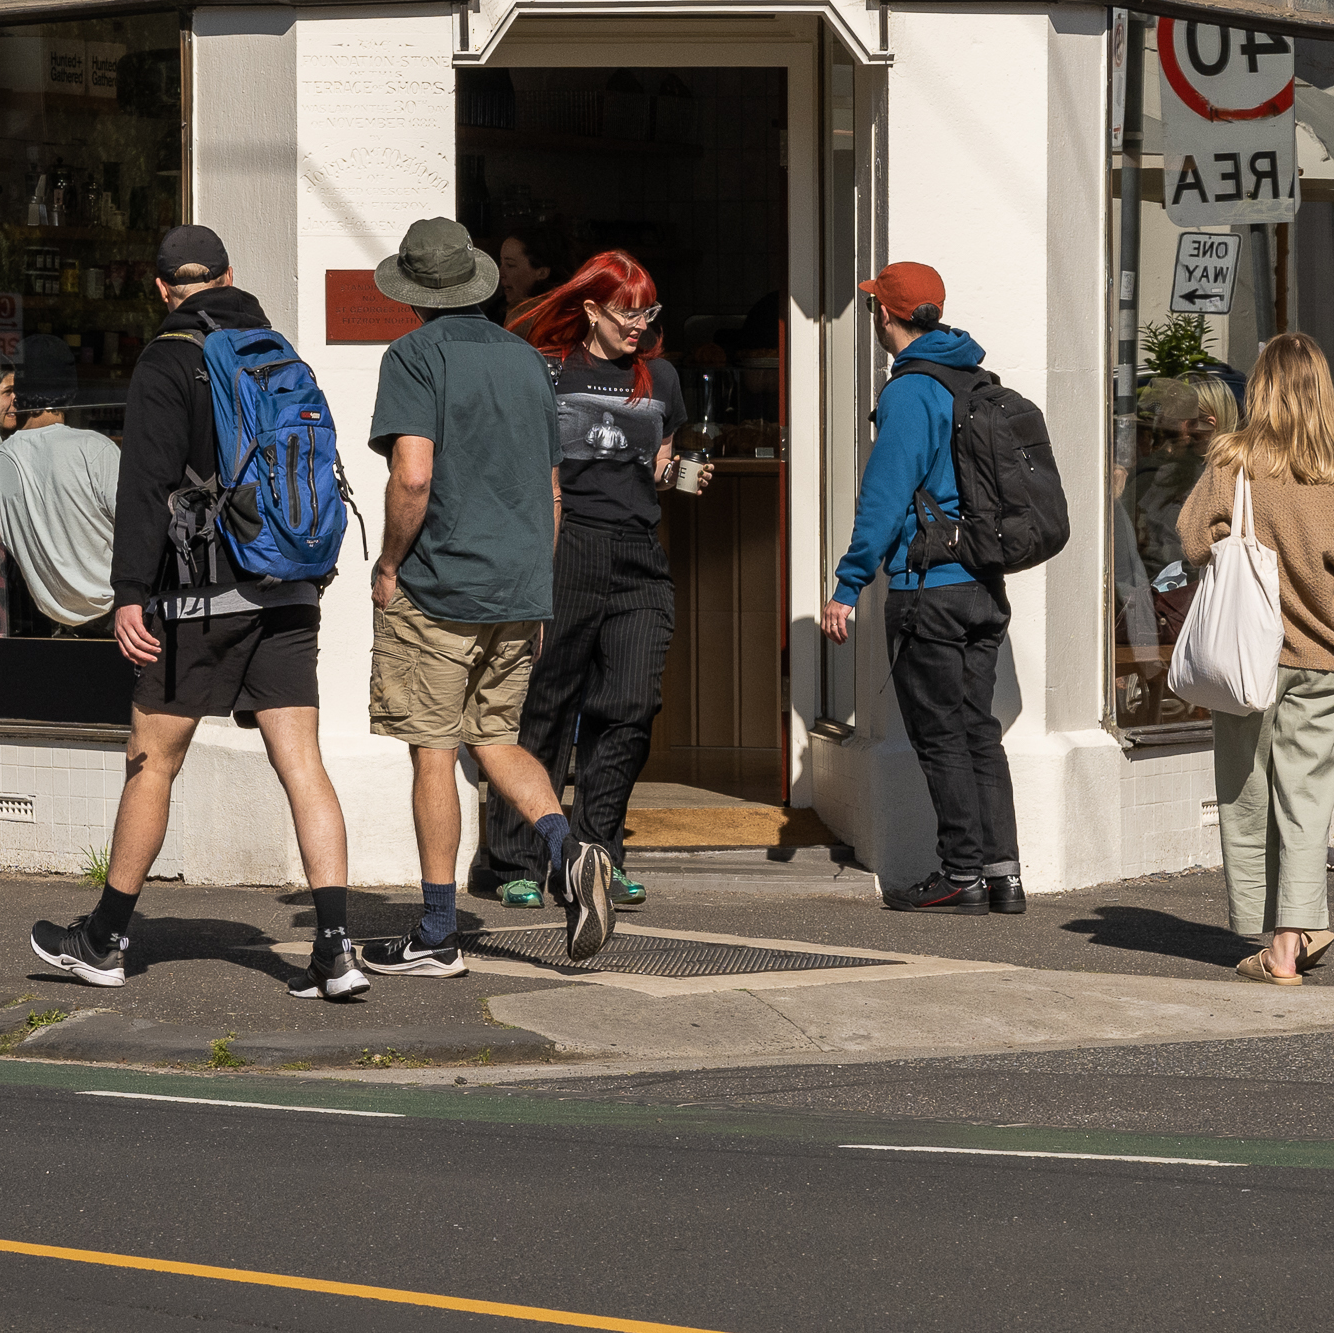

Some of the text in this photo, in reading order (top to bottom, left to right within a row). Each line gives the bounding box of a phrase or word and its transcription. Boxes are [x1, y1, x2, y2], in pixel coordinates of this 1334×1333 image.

[50, 66, 84, 84] Gathered
[301, 80, 373, 94] TERRACE
[301, 104, 327, 114] WAS
[328, 104, 352, 114] LAID
[368, 104, 392, 114] THE
[428, 104, 450, 114] DAY
[326, 117, 406, 129] NOVEMBER
[319, 187, 430, 196] ALFRED CRESCENT
[321, 201, 364, 211] NORTH
[301, 216, 344, 232] JAMES
[344, 216, 396, 232] HOLDEN
